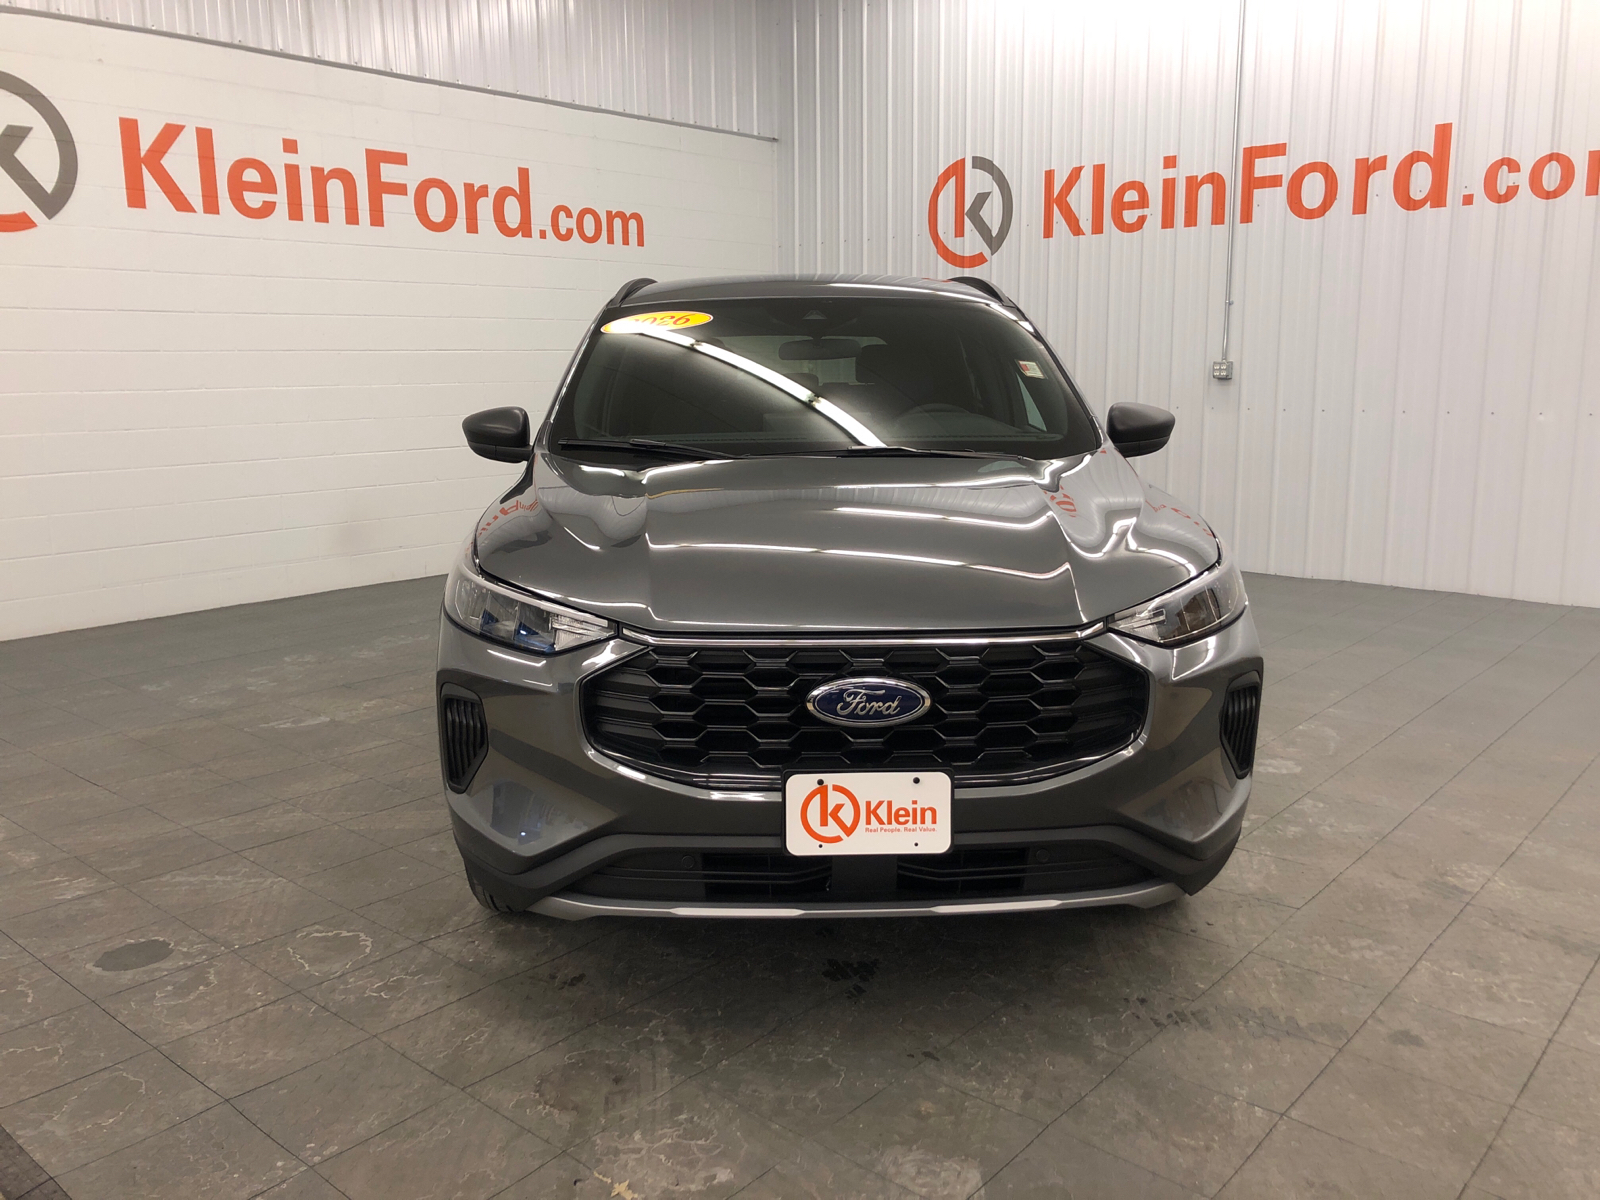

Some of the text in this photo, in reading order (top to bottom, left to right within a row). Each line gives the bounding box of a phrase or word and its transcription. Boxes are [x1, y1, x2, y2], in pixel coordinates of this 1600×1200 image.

[118, 116, 645, 247] KleinFord.com
[836, 688, 902, 716] Ford
[865, 799, 938, 826] Klein
[880, 826, 903, 834] People.
